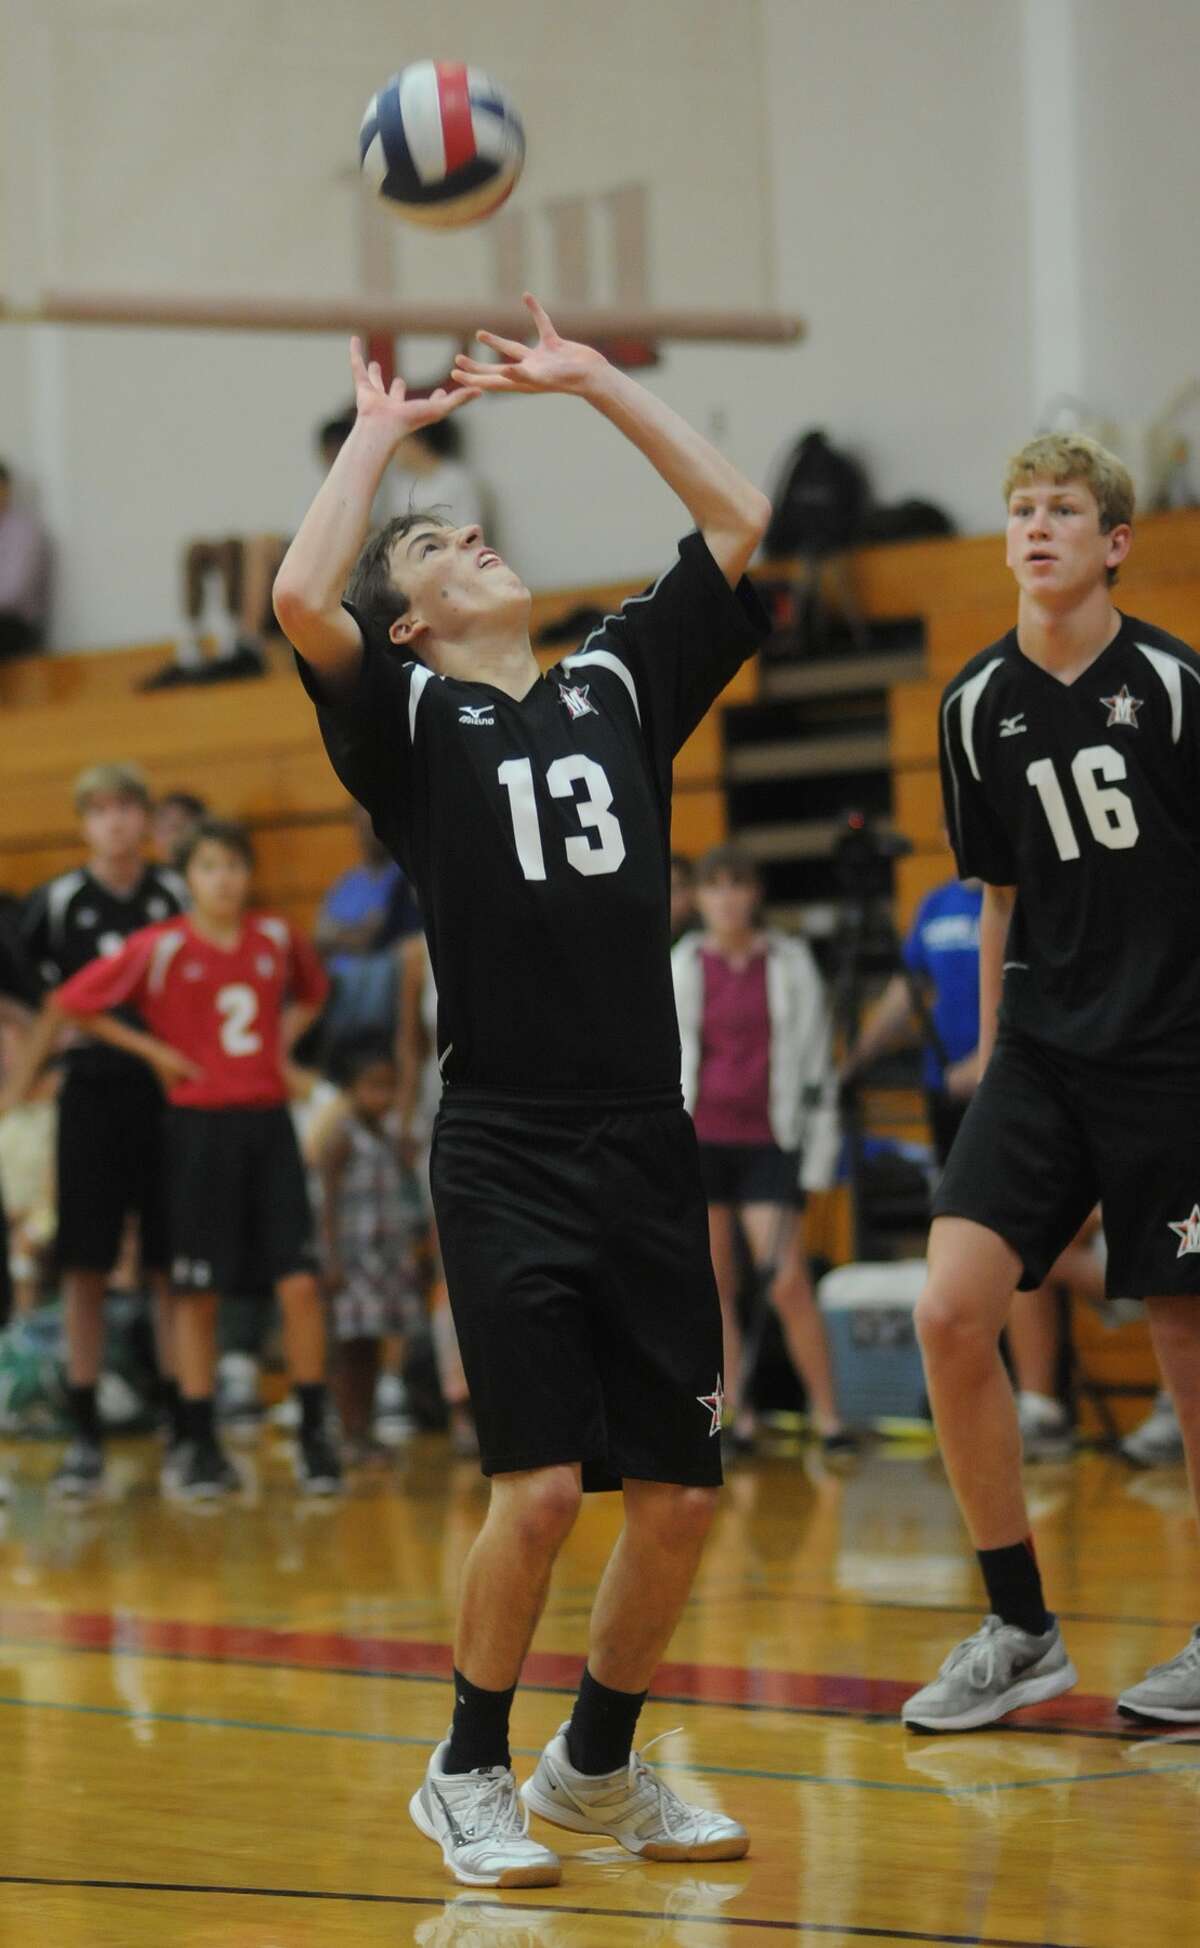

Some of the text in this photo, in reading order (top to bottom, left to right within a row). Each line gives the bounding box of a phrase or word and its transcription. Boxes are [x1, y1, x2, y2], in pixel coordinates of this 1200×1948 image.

[498, 754, 626, 880] 13
[1026, 744, 1140, 862] 16
[216, 984, 262, 1057] 2
